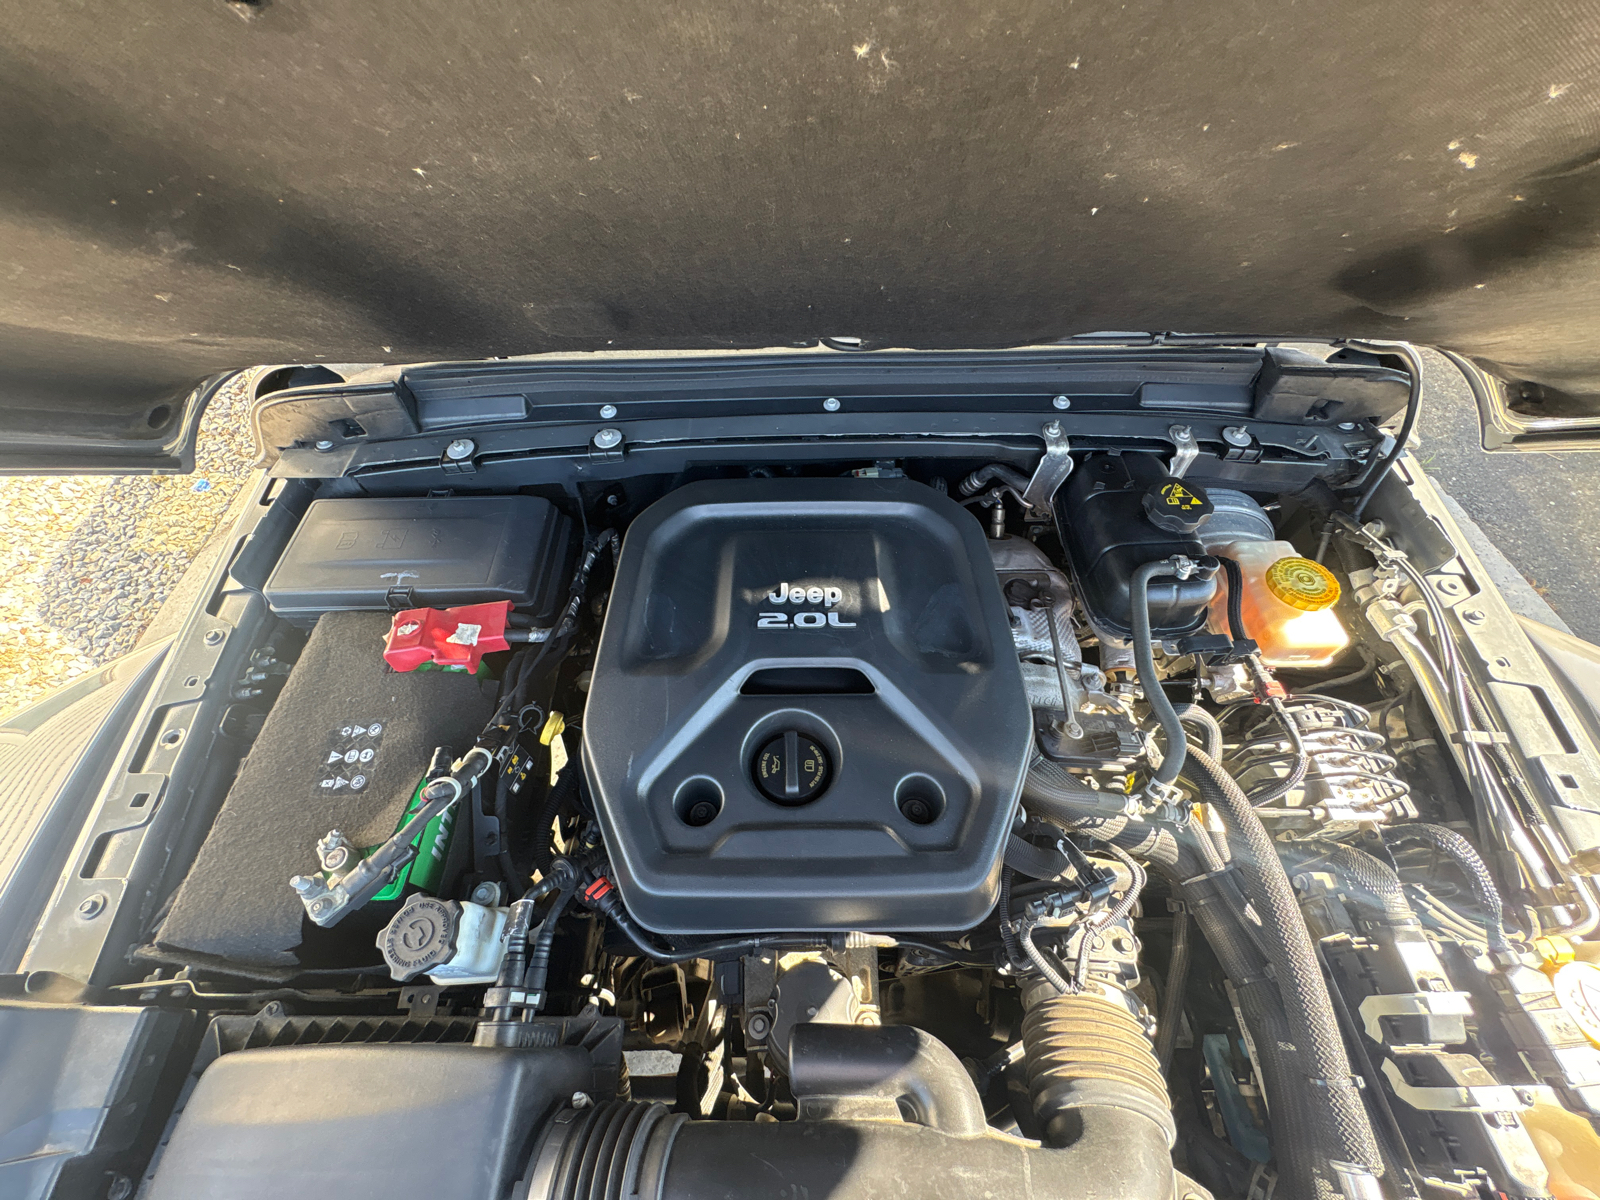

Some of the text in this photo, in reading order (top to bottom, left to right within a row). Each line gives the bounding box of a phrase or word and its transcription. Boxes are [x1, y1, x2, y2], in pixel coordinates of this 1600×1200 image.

[768, 582, 842, 607] Jeep
[757, 612, 857, 630] 2.0L
[761, 761, 769, 778] ENGINE
[431, 808, 453, 862] INT
[419, 902, 450, 945] USE APPROVED
[413, 950, 437, 966] FLUID
